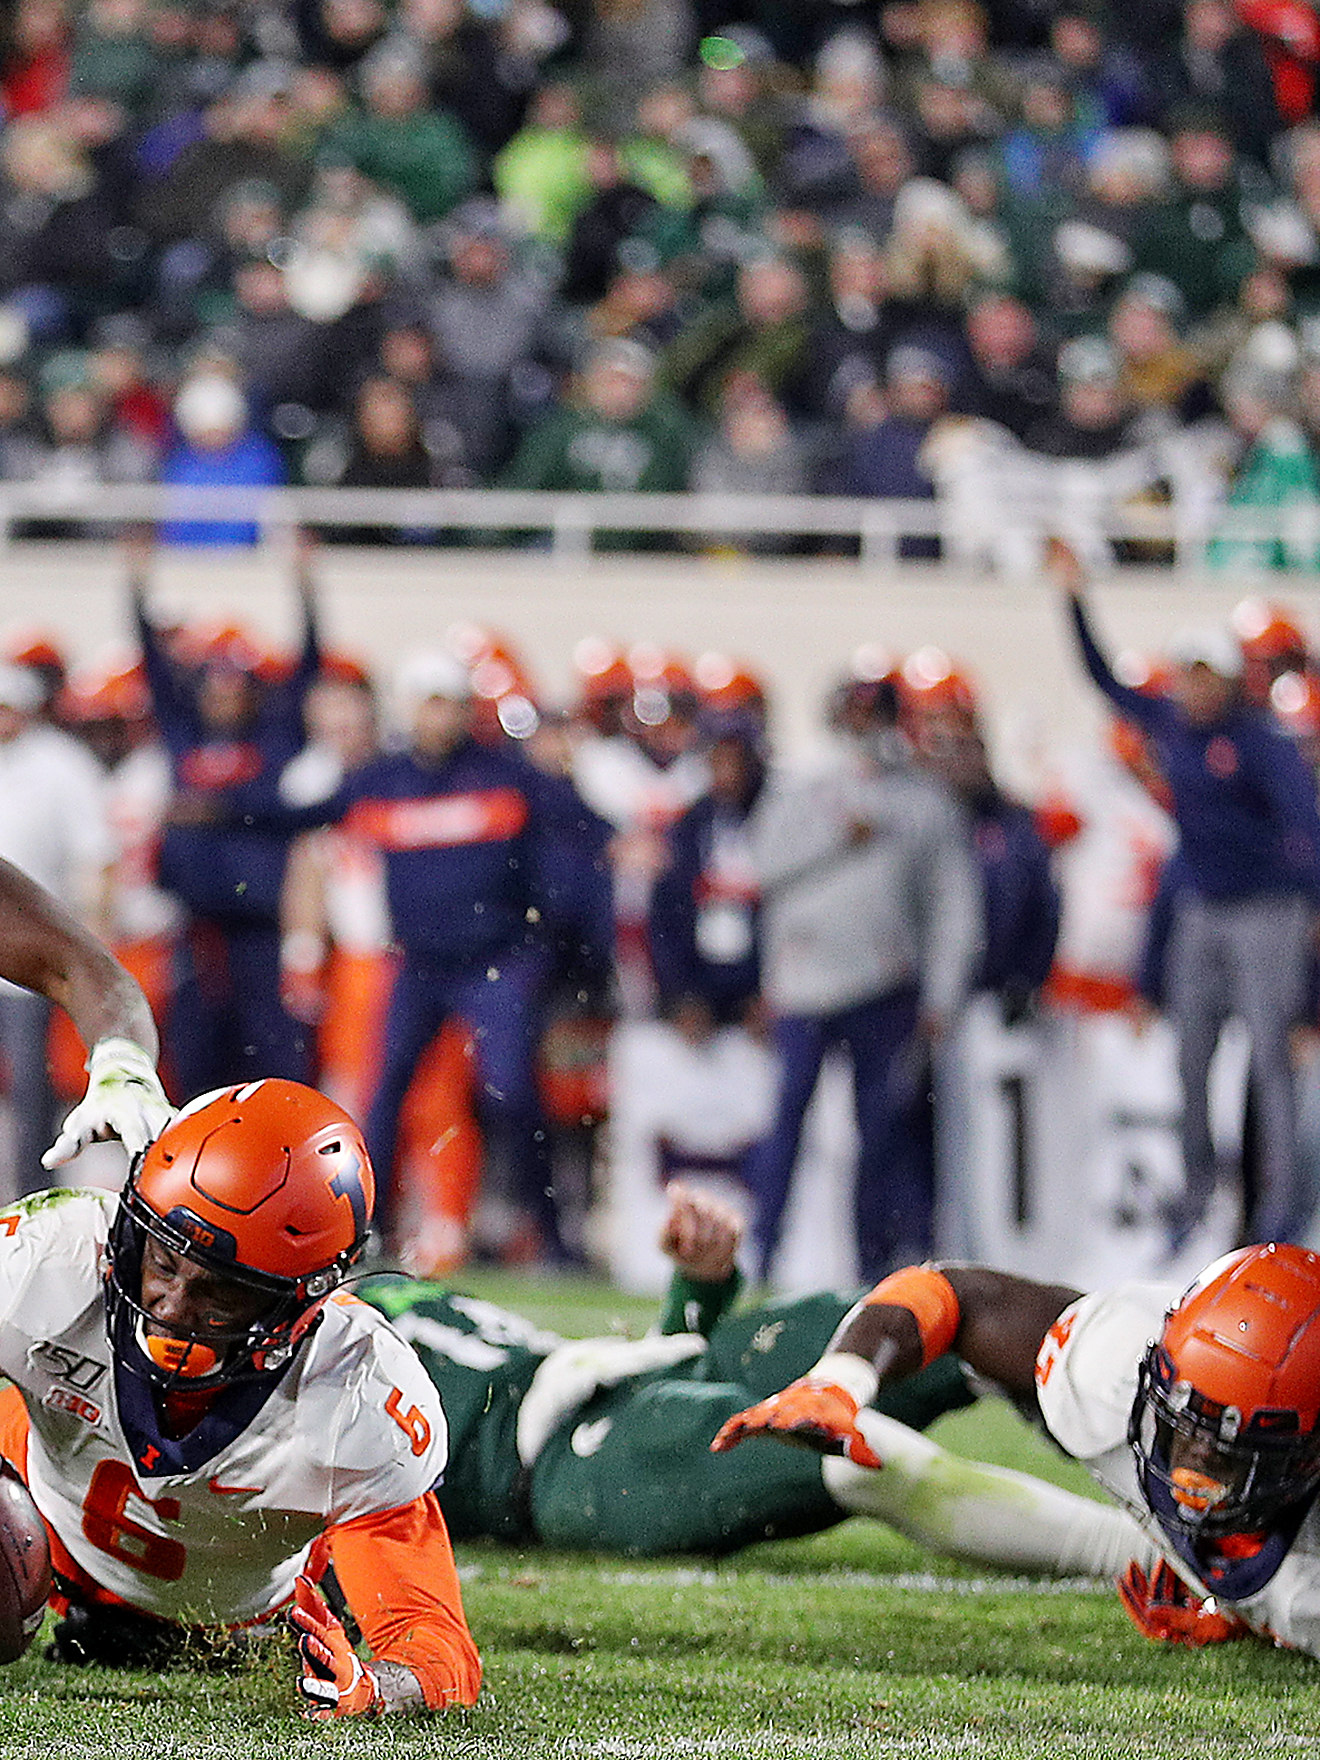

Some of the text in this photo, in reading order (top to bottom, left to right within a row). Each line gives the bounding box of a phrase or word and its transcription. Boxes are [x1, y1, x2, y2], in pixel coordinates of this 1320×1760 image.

[30, 1340, 108, 1391] 50
[384, 1386, 432, 1458] 6
[81, 1458, 188, 1582] 6
